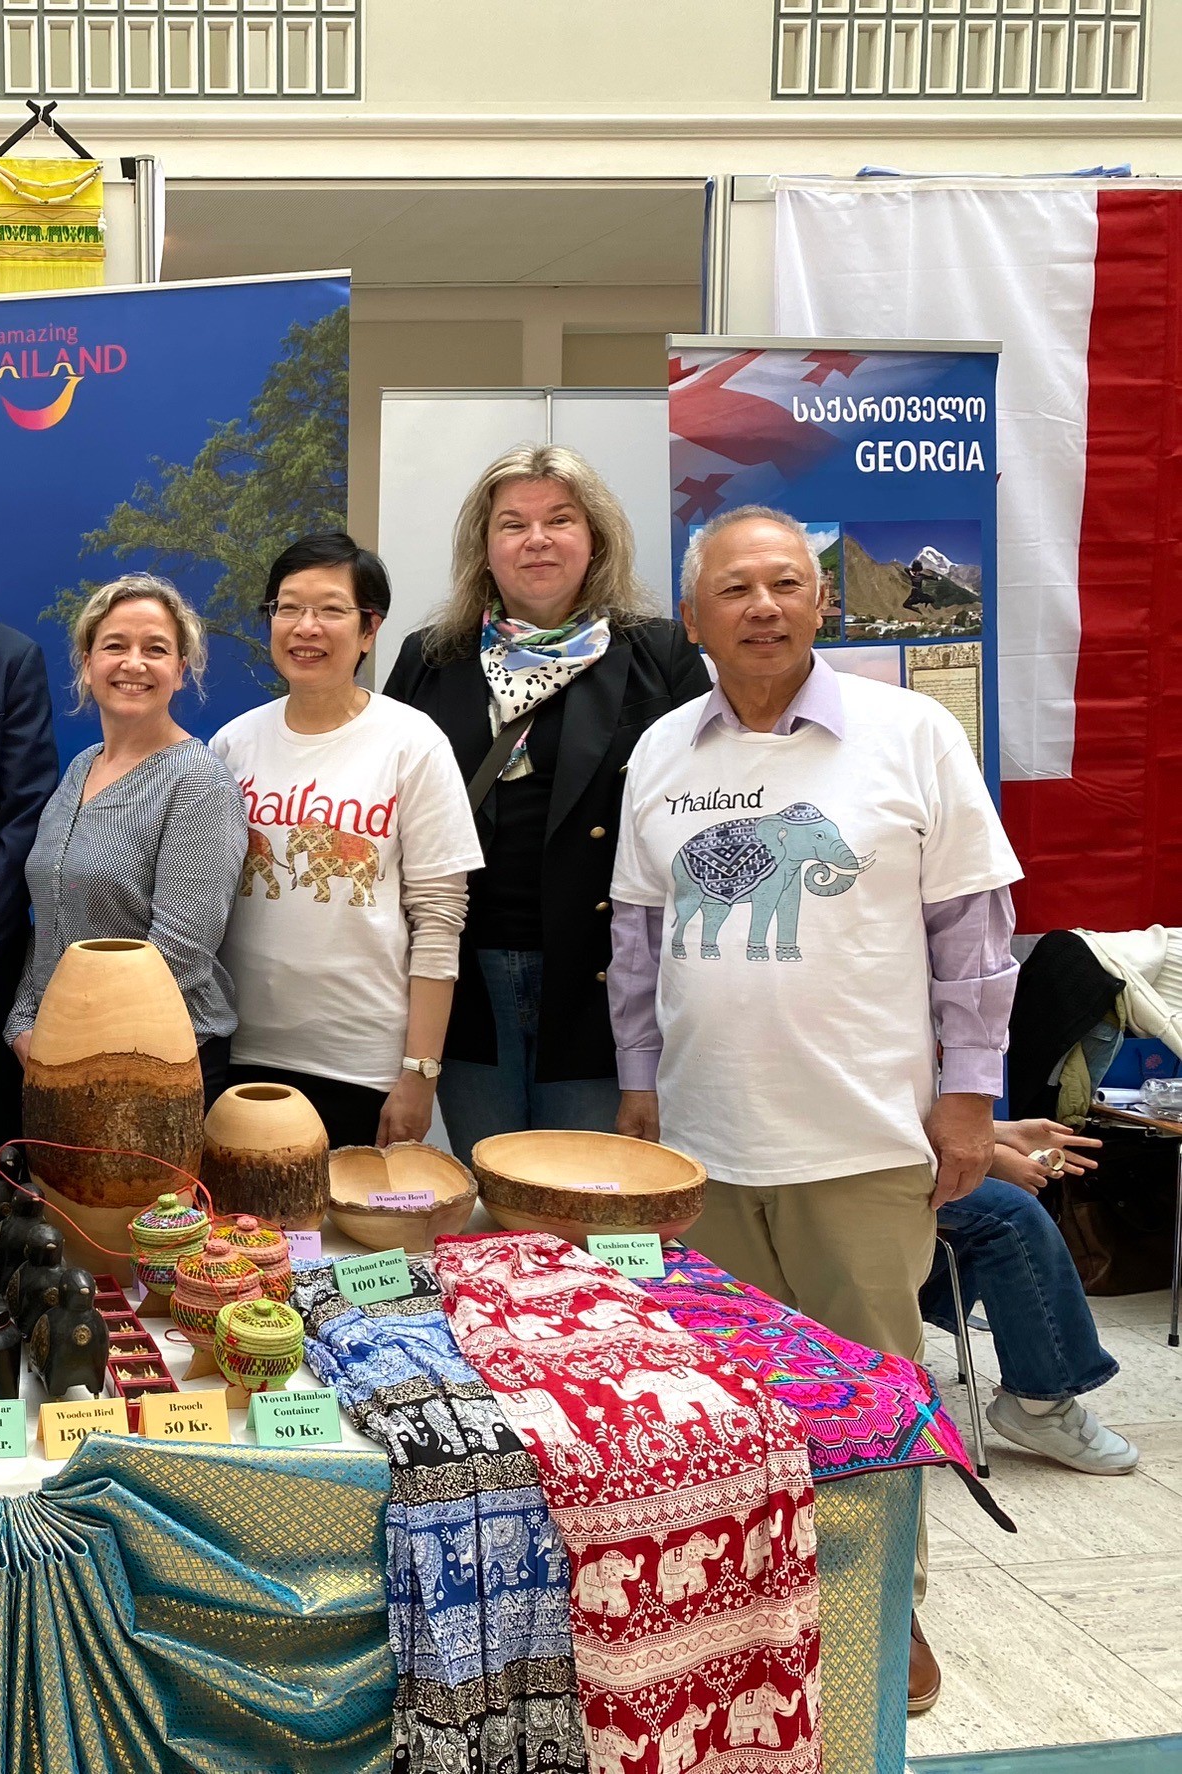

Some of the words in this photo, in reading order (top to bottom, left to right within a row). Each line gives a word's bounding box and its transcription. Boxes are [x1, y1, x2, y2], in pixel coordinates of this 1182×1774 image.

[792, 396, 986, 423] საქართველო
[855, 440, 985, 472] GEORGIA
[239, 774, 397, 838] hailand
[664, 785, 764, 815] Thailand
[375, 1194, 406, 1202] Wooden
[341, 1262, 378, 1276] Elephant
[379, 1257, 403, 1269] Pants
[607, 1256, 624, 1266] 50
[627, 1255, 649, 1265] Kr.
[351, 1278, 376, 1293] 100
[379, 1275, 400, 1286] Kr.
[258, 1395, 291, 1404] Woven
[293, 1392, 331, 1401] Bamboo
[56, 1411, 92, 1420] Wooden
[94, 1408, 114, 1417] Bird
[169, 1402, 203, 1412] Brooch
[273, 1406, 320, 1416] Container
[164, 1421, 183, 1434] 50
[188, 1419, 212, 1432] Kr.
[275, 1425, 295, 1438] 80
[299, 1424, 324, 1436] Kr.
[59, 1427, 87, 1442] 150
